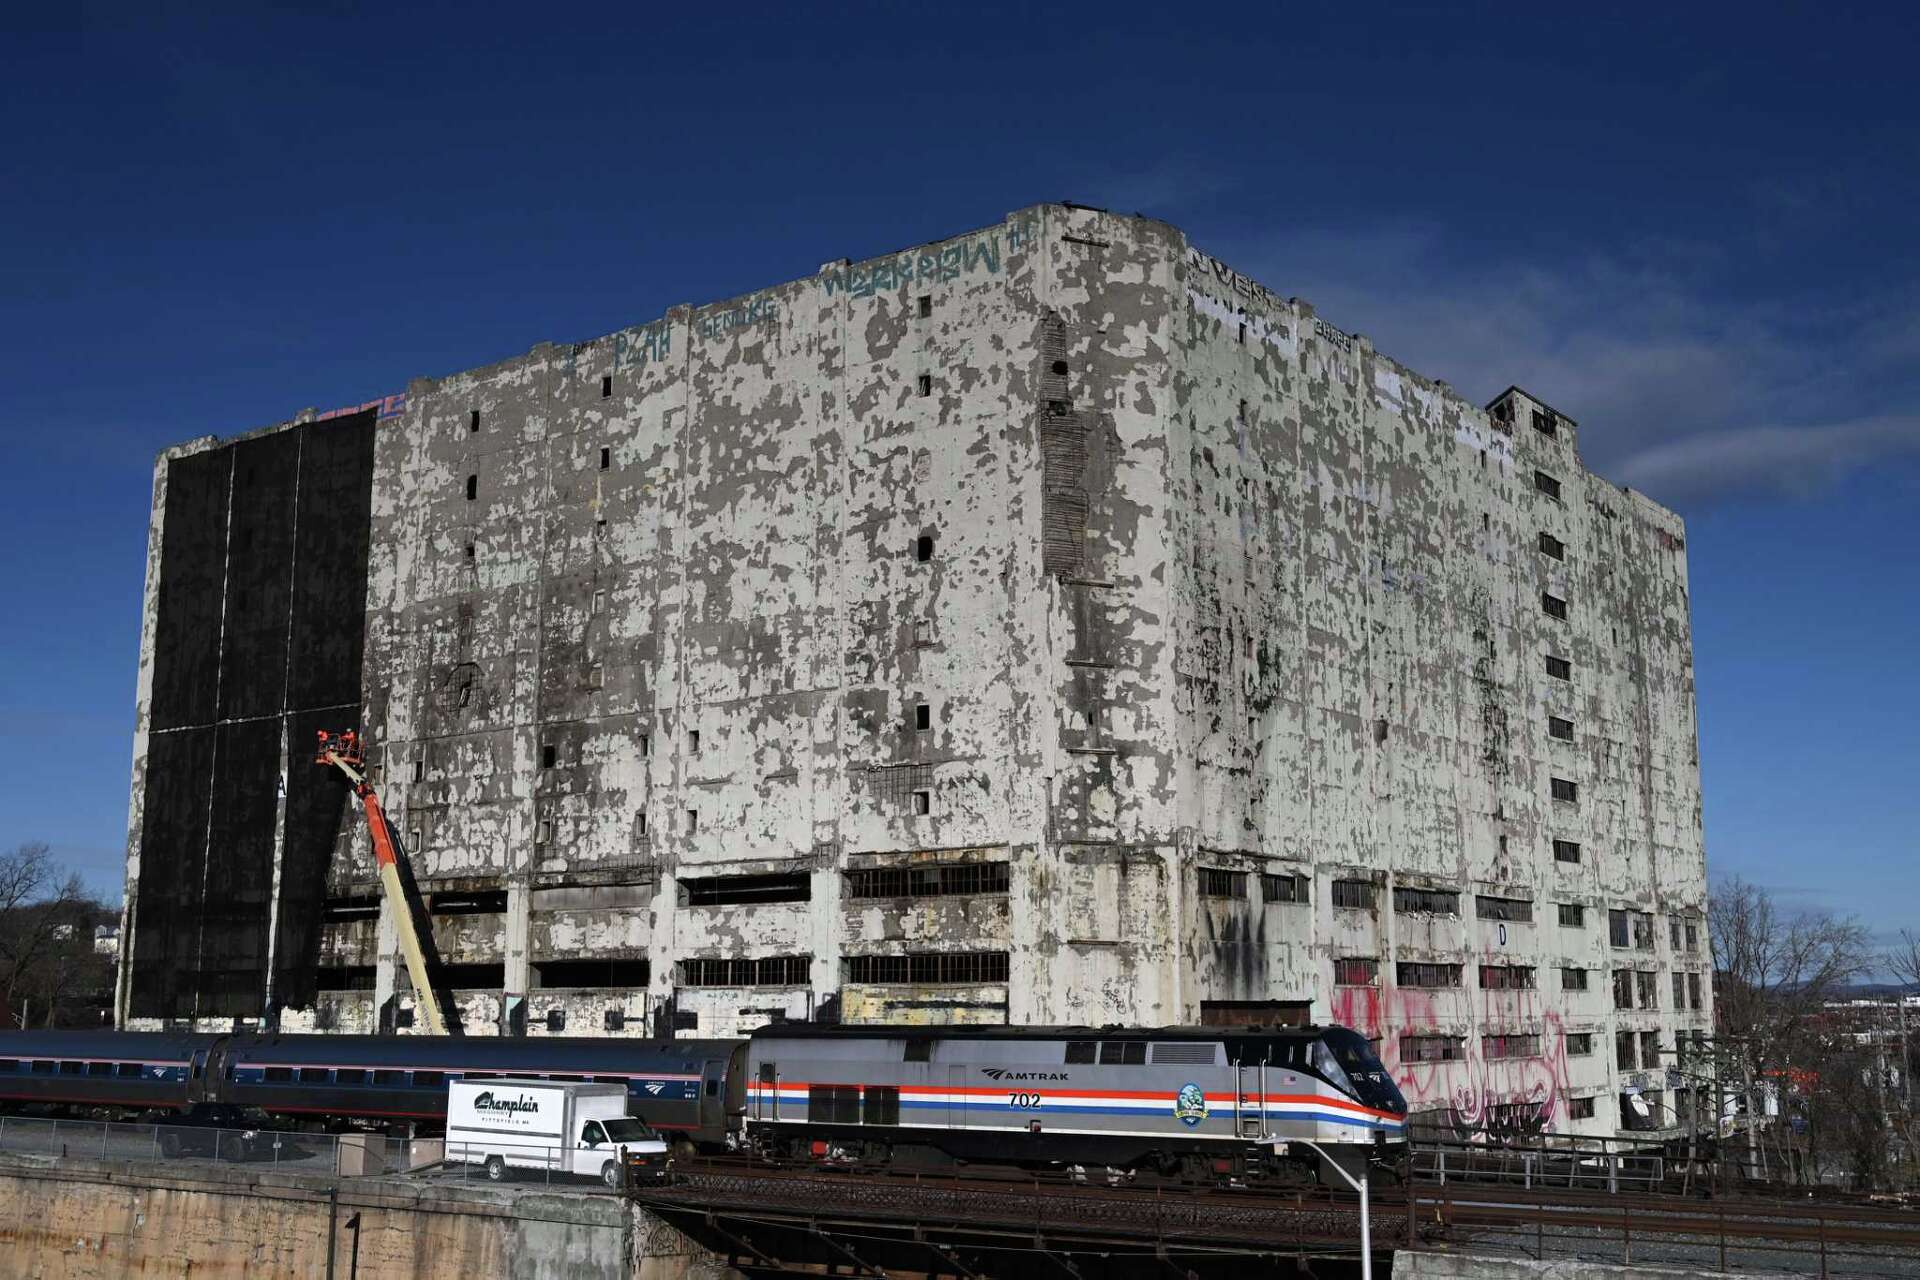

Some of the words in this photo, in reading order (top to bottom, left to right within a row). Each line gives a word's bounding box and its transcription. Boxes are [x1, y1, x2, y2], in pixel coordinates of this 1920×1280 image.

[1004, 1072, 1069, 1081] AMTRAK
[474, 1091, 539, 1119] Champlain
[1008, 1092, 1041, 1109] 702
